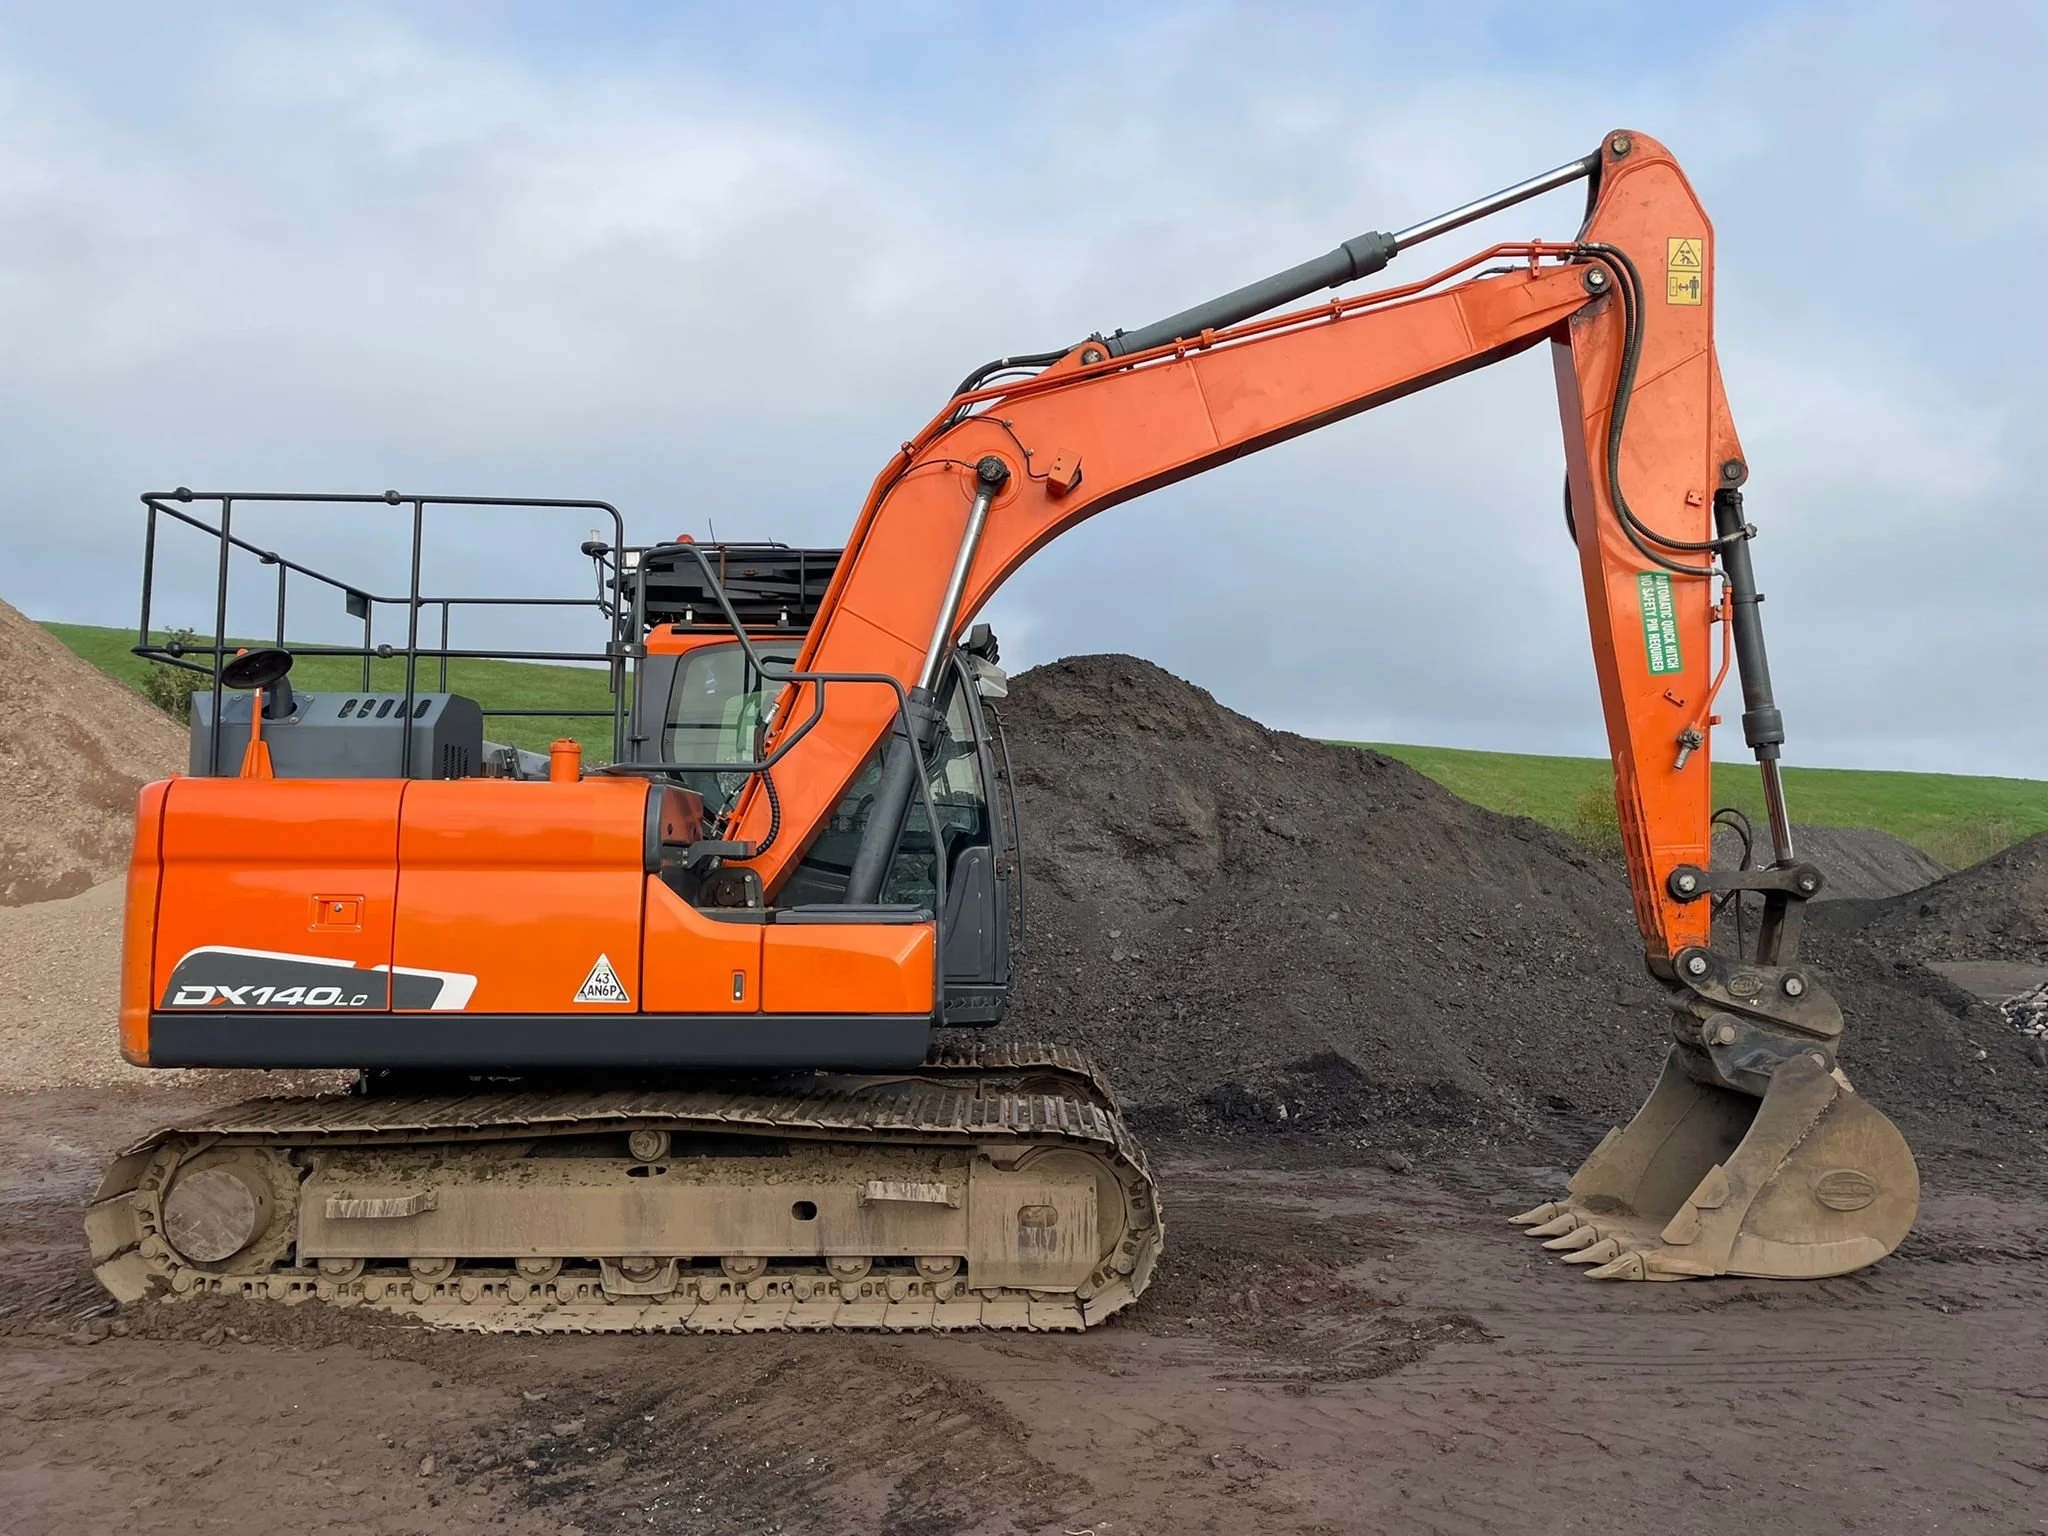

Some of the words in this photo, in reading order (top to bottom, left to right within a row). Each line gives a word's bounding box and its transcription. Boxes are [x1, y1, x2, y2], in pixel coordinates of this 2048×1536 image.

[1640, 574, 1653, 586] NO
[1642, 587, 1657, 616] SAFETY
[1656, 575, 1672, 618] AUTOMATIC
[1646, 618, 1660, 632] PIN
[1661, 620, 1676, 644] QUICK
[1648, 633, 1664, 671] REQUIRED
[1665, 645, 1679, 669] HITCH
[595, 972, 610, 984] 43
[587, 985, 617, 996] AN6P
